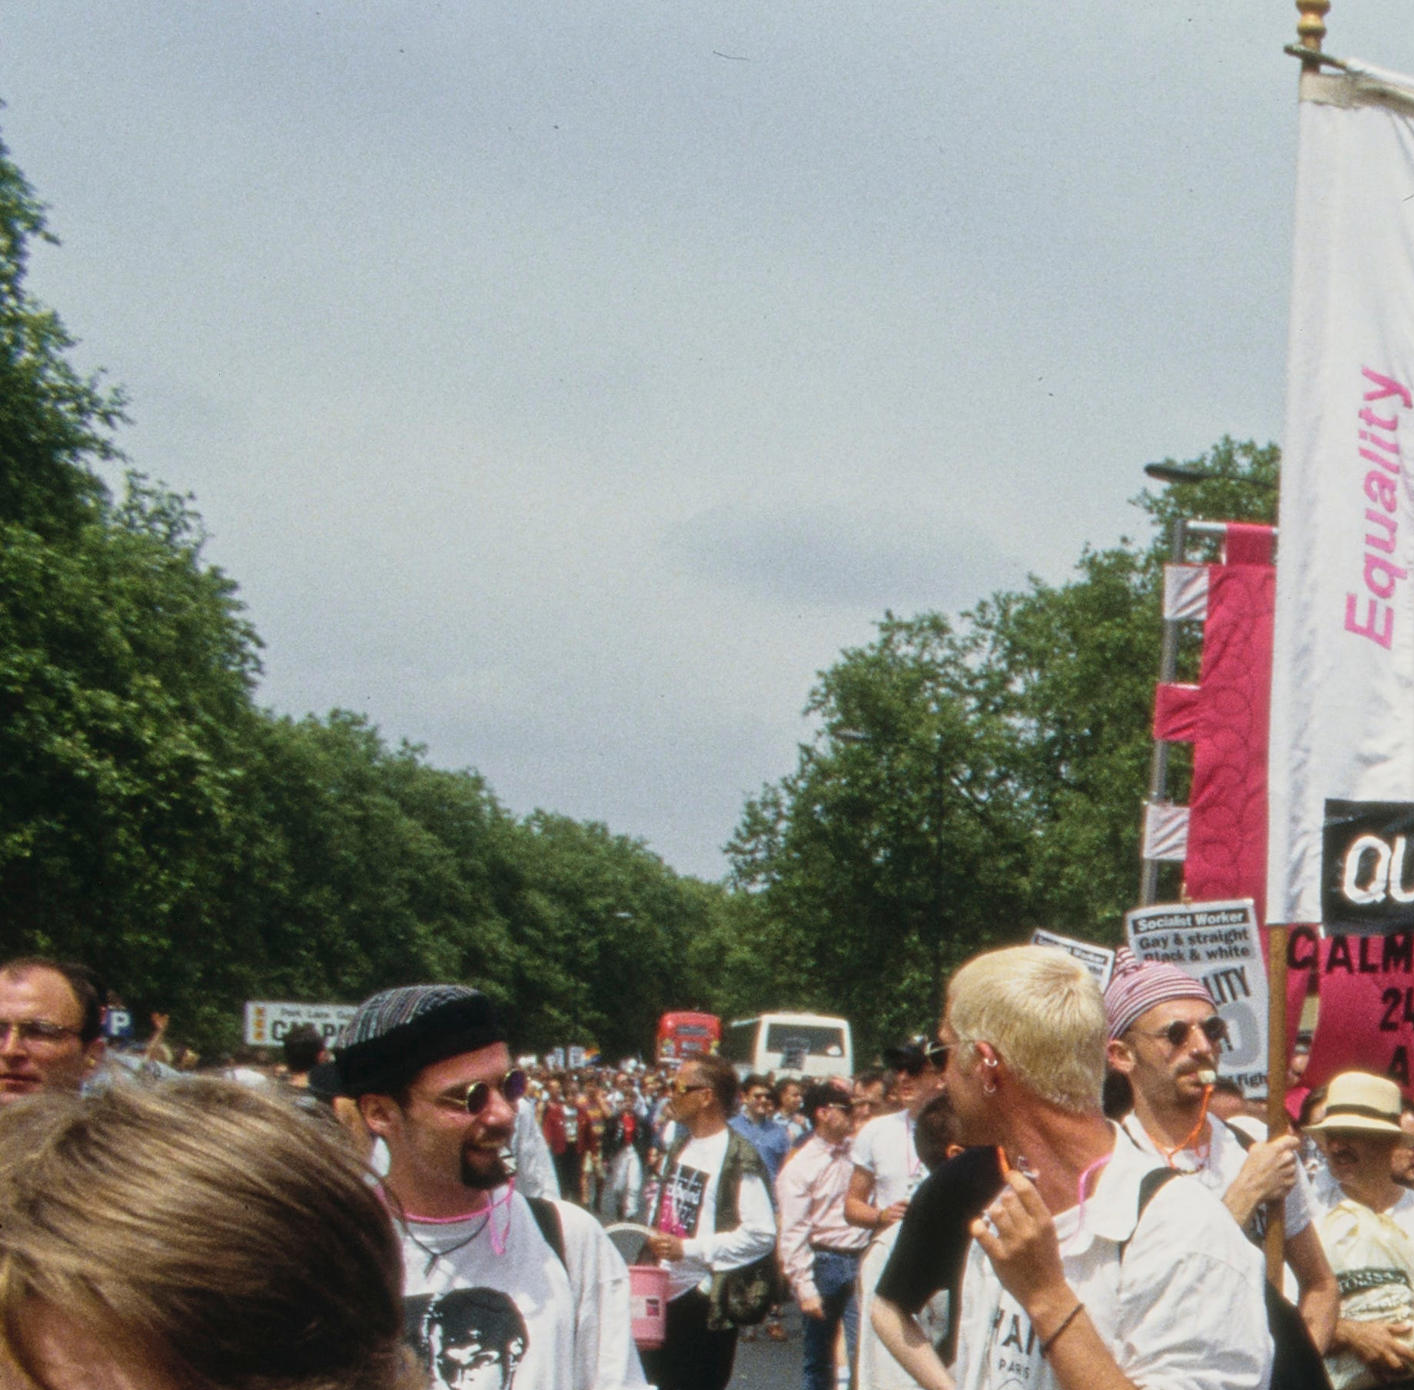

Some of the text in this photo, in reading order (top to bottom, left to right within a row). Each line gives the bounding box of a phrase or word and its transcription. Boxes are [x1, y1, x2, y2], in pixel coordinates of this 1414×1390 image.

[1344, 365, 1414, 650] Equality
[1137, 911, 1244, 933] Socialist Worker
[1139, 936, 1169, 950] Gay
[1187, 927, 1250, 945] straight
[1206, 945, 1250, 960] white
[1286, 926, 1414, 974] CALM
[1386, 1044, 1411, 1086] A
